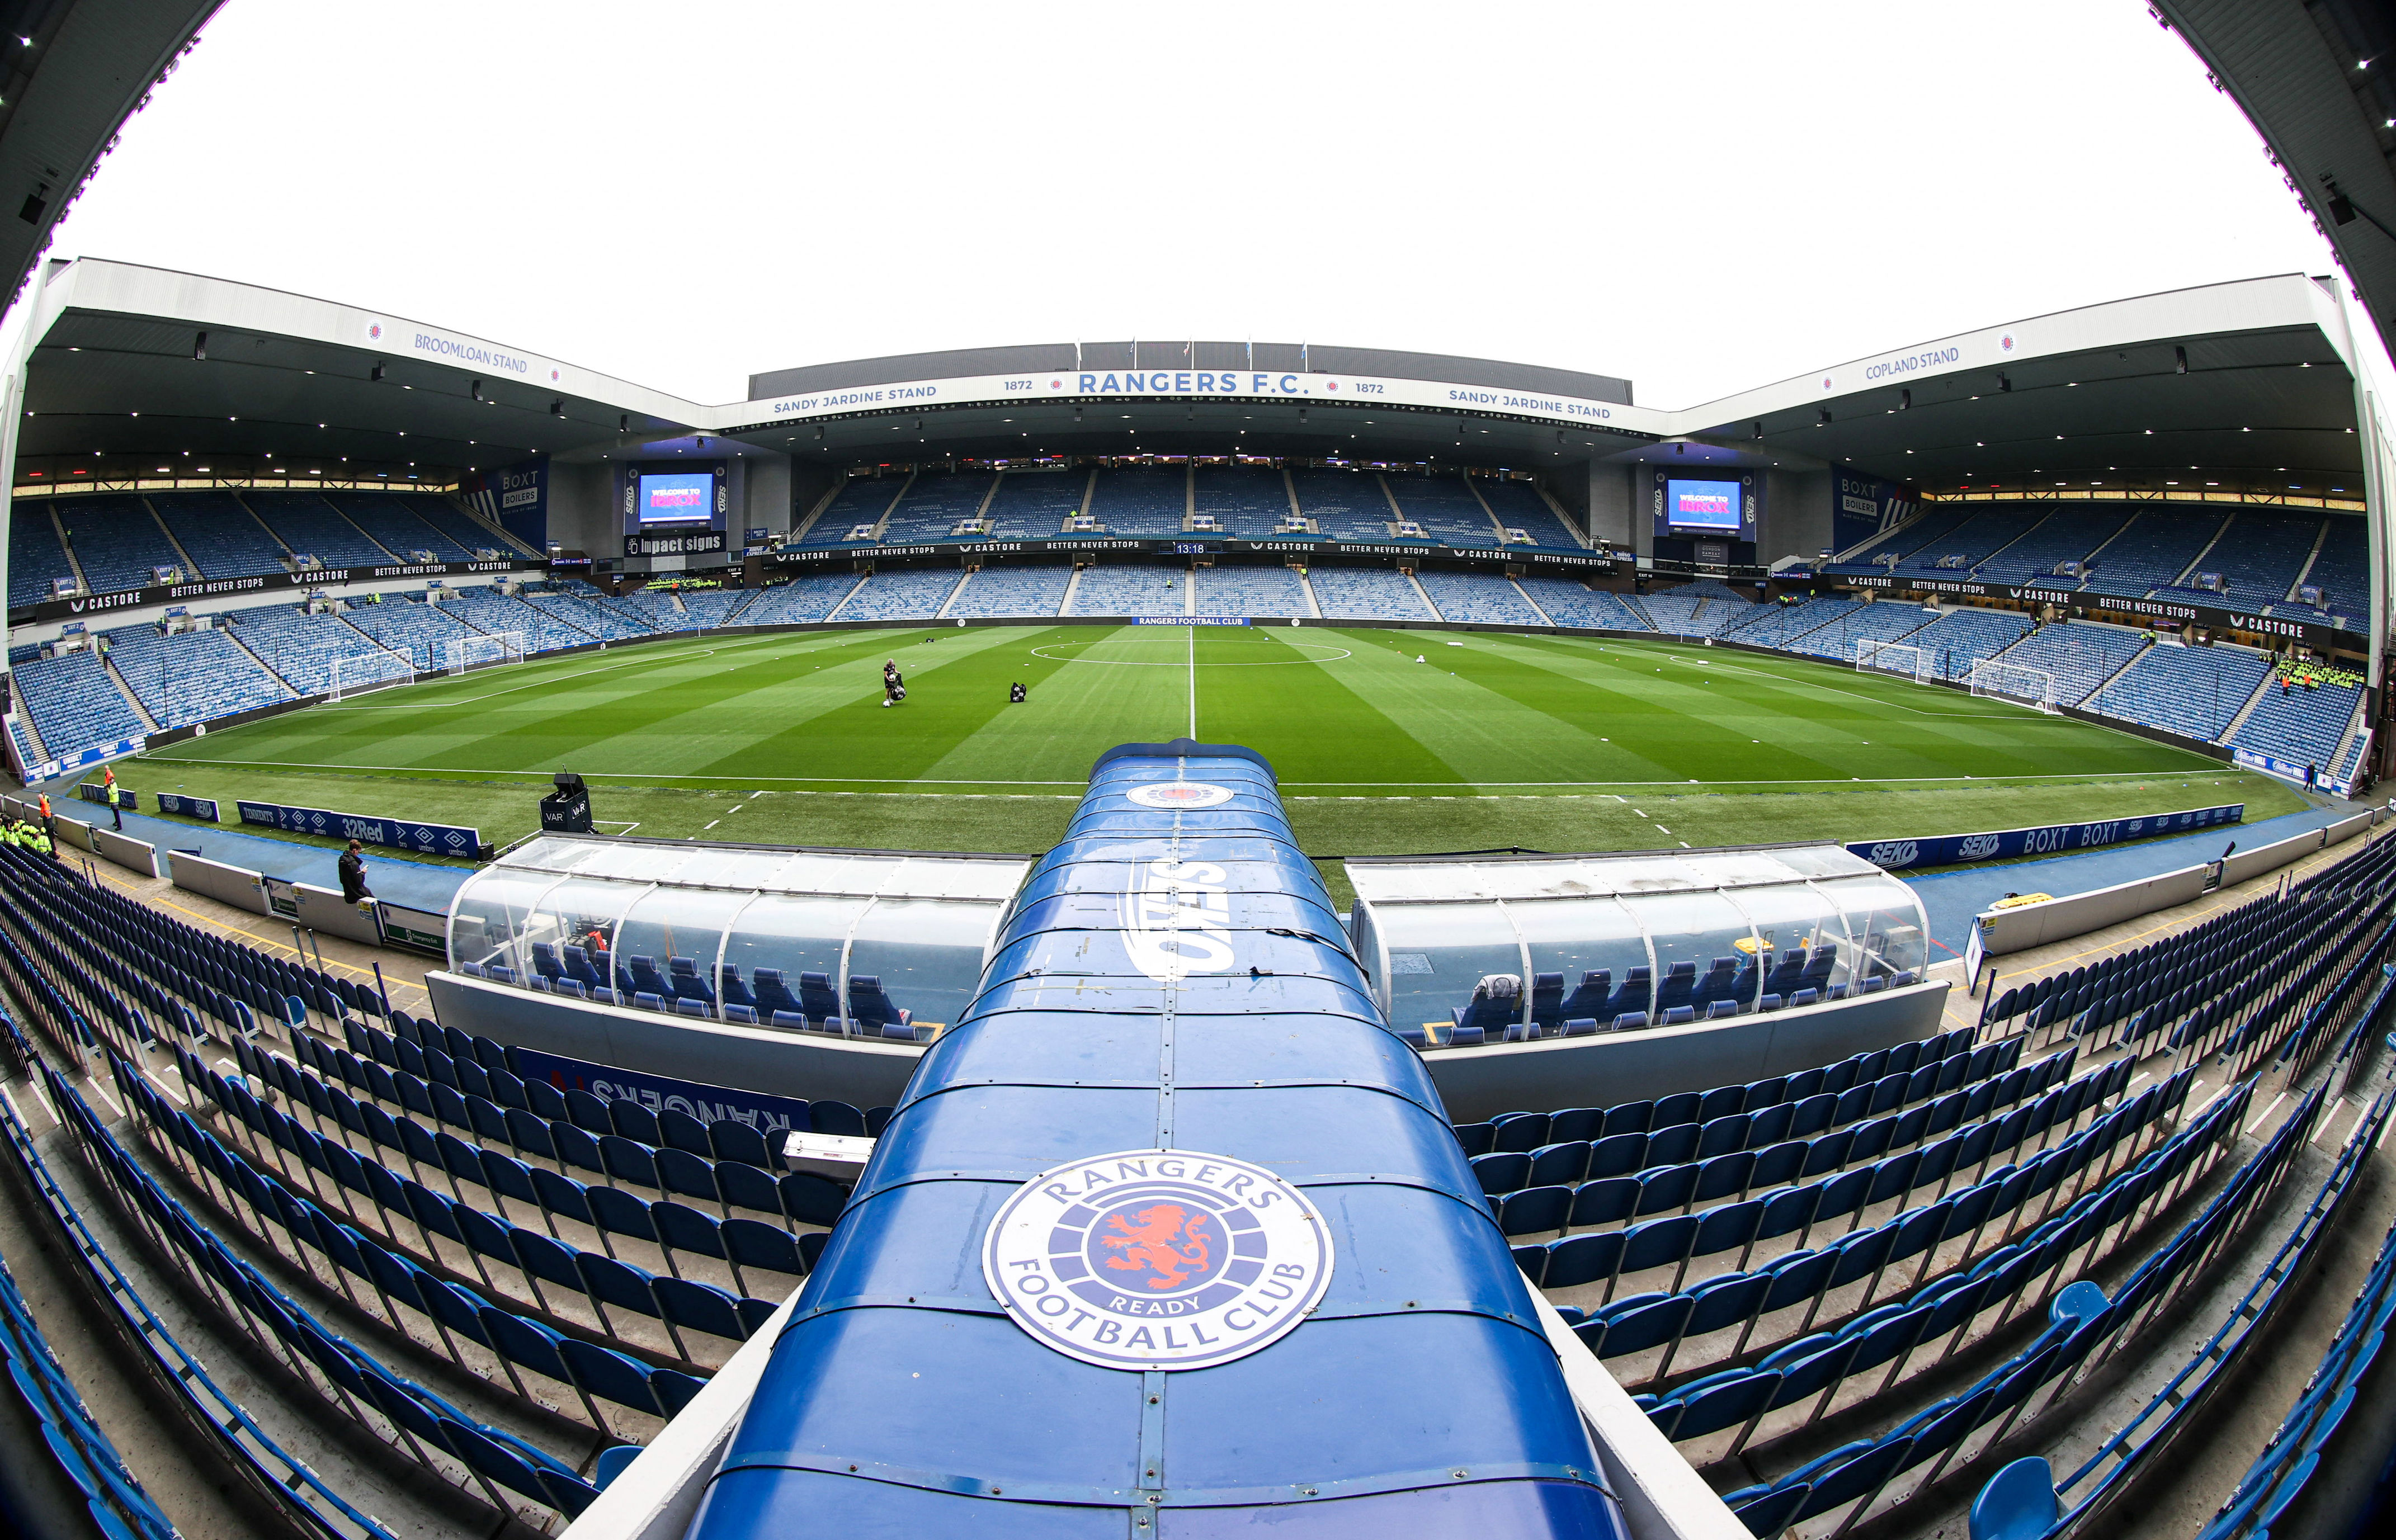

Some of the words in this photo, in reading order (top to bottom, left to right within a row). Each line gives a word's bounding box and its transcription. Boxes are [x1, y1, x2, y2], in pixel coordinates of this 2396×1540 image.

[415, 334, 491, 365] BROOMLOAN
[493, 354, 527, 374] STAND
[1866, 357, 1918, 380] COPLAND
[1920, 347, 1959, 367] STAND
[1004, 380, 1032, 390] 1872
[1079, 372, 1237, 393] RANGERS
[1253, 374, 1309, 394] F.C.
[1356, 383, 1384, 393] 1872
[774, 398, 818, 413] SANDY
[823, 391, 883, 407] JARDINE
[888, 386, 937, 399] STAND
[1449, 390, 1498, 404] SANDY
[1503, 396, 1562, 412] JARDINE
[1567, 404, 1611, 419] STAND
[504, 470, 538, 490] BOXT
[1842, 478, 1876, 498] BOXT
[506, 491, 535, 504] BOILERS
[626, 485, 635, 514] SEKO
[650, 494, 701, 507] IBROX
[717, 485, 727, 513] SEKO
[1654, 489, 1663, 517] SEKO
[1679, 500, 1730, 513] IBROX
[1746, 495, 1754, 523] SEKO
[1846, 500, 1875, 512] BOILERS
[641, 538, 682, 554] Impact
[686, 536, 720, 551] signs
[975, 543, 1021, 552] CASTORE
[1177, 544, 1204, 554] 13:18
[1267, 542, 1315, 551] CASTORE
[1374, 546, 1402, 554] NEVER
[1403, 547, 1430, 555] STOPS
[790, 551, 829, 561] CASTORE
[1469, 550, 1512, 560] CASTORE
[1534, 555, 1560, 563] BETTER
[1563, 556, 1587, 565] NEVER
[375, 566, 400, 577] BETTER
[403, 565, 423, 575] NEVER
[426, 564, 446, 573] STOPS
[479, 561, 511, 570] CASTORE
[306, 570, 348, 582] CASTORE
[1859, 577, 1892, 587] CASTORE
[172, 584, 203, 597] BETTER
[207, 582, 233, 593] NEVER
[237, 578, 263, 589] STOPS
[1912, 580, 1936, 590] BETTER
[1938, 583, 1960, 592] NEVER
[1962, 584, 1984, 594] STOPS
[89, 592, 140, 610] CASTORE
[2025, 589, 2069, 603] CASTORE
[2100, 598, 2131, 611] BETTER
[2135, 602, 2163, 615] NEVER
[2167, 606, 2196, 619] STOPS
[2248, 617, 2304, 638] CASTORE
[99, 742, 119, 754] UNIBET
[63, 753, 83, 765] UNIBET
[2254, 754, 2266, 766] HILL
[2293, 766, 2305, 778] HILL
[164, 796, 180, 811] SEKO
[195, 800, 212, 815] SEKO
[572, 803, 586, 816] VAR
[243, 807, 274, 823] TENNENT'S
[545, 812, 563, 821] VAR
[342, 818, 384, 843] 32Red
[2081, 821, 2120, 847] BOXT
[1959, 834, 1999, 857] SEKO
[2023, 827, 2069, 854] BOXT
[418, 844, 435, 853] umbro
[449, 848, 468, 857] umbro
[1868, 841, 1919, 865] SEKO
[1141, 857, 1235, 982] SEKO
[412, 933, 431, 943] Emergency
[1042, 1160, 1282, 1210] RANGERS
[1008, 1258, 1219, 1350] FOOTBALL
[1224, 1263, 1305, 1331] CLUB
[1109, 1296, 1200, 1315] READY
